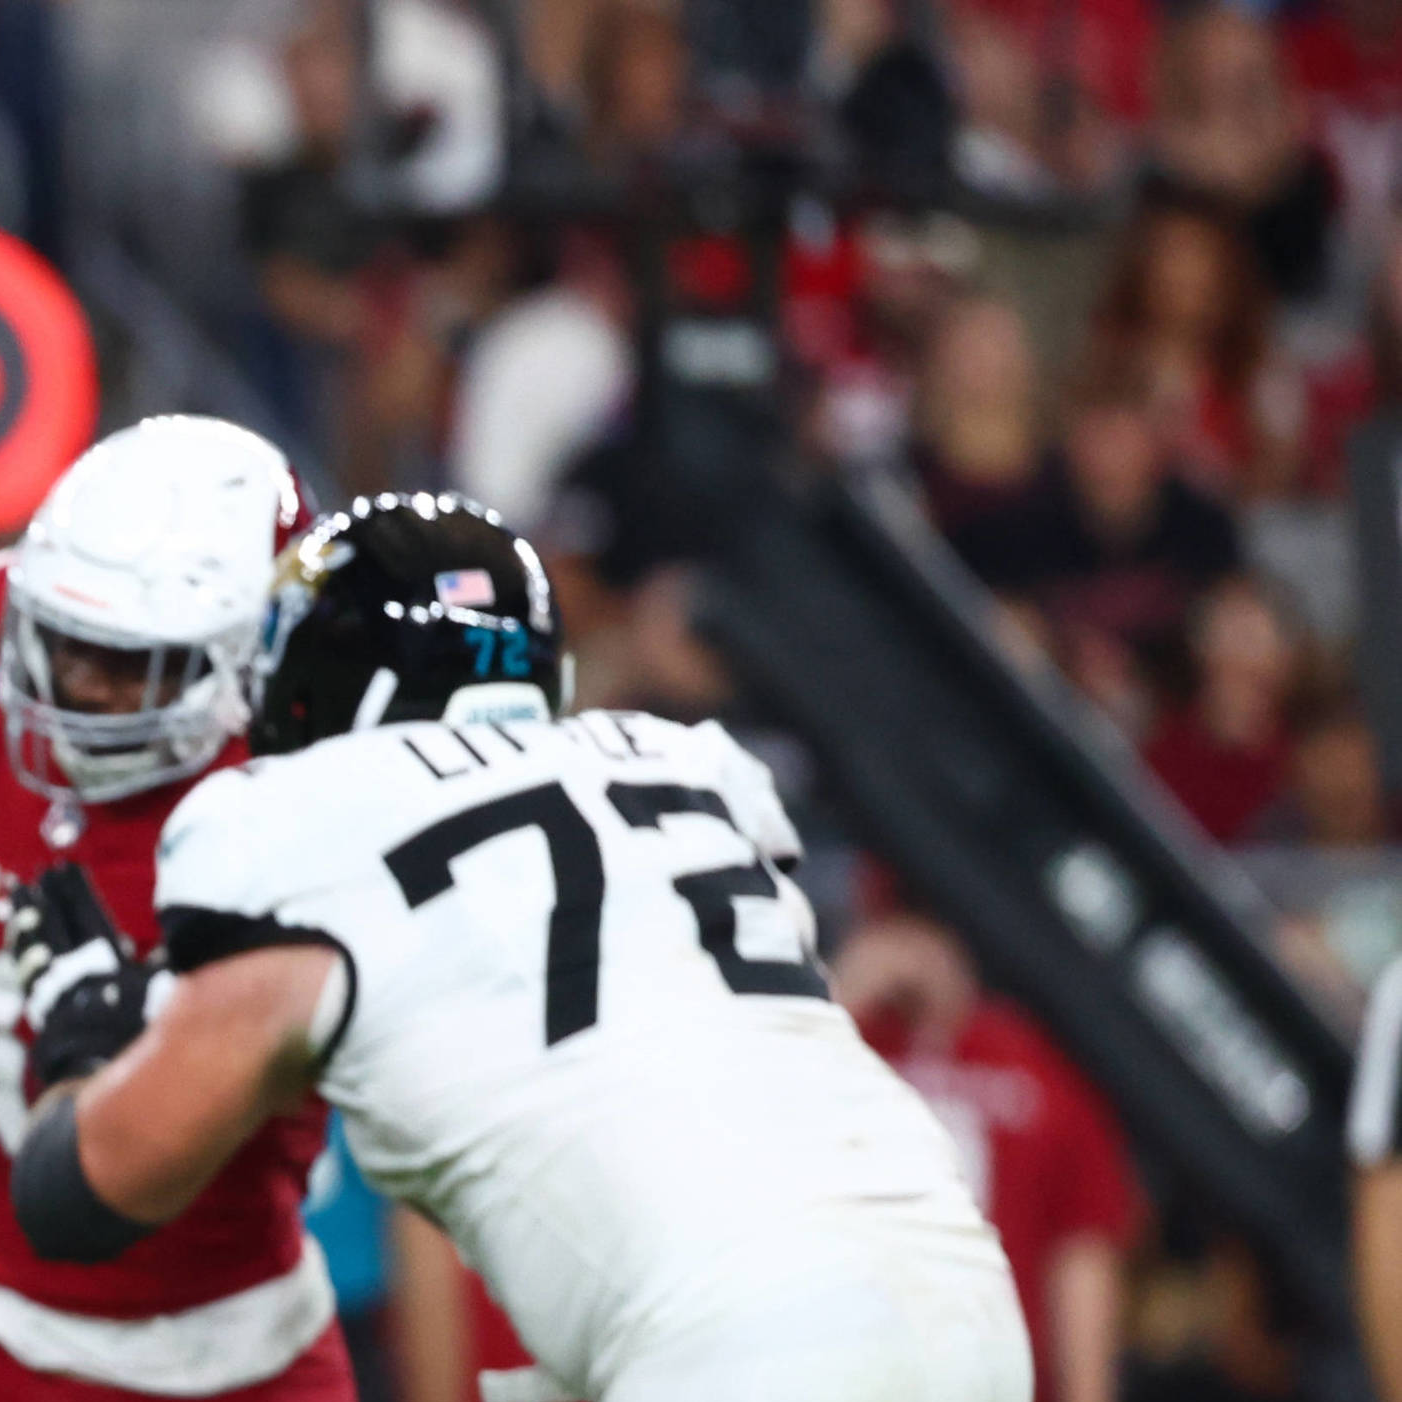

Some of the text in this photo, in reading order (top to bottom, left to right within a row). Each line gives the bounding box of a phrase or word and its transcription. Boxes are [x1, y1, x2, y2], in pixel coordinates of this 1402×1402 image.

[464, 624, 531, 677] 72
[401, 712, 665, 780] LITLE
[381, 780, 833, 1049] 72
